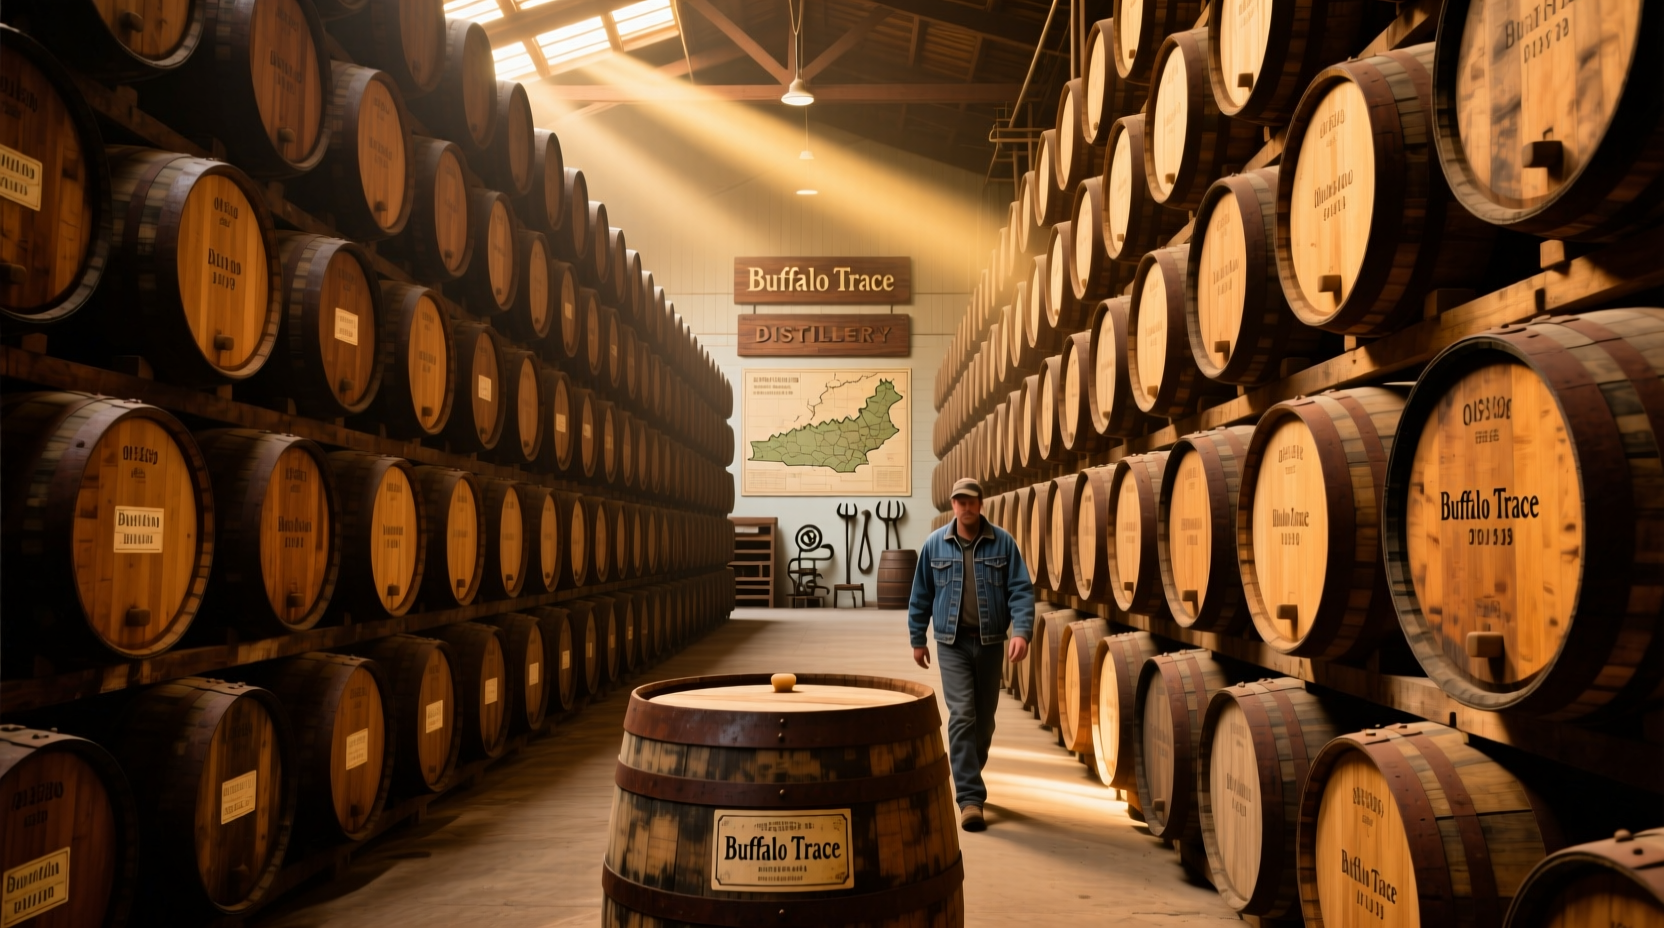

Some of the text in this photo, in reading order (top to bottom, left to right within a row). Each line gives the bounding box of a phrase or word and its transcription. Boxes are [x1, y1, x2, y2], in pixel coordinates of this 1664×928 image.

[747, 266, 895, 292] Buffalo Trace
[755, 325, 892, 343] DISTILLERY
[1493, 487, 1540, 519] Trace
[724, 835, 841, 861] Buffalo Trace
